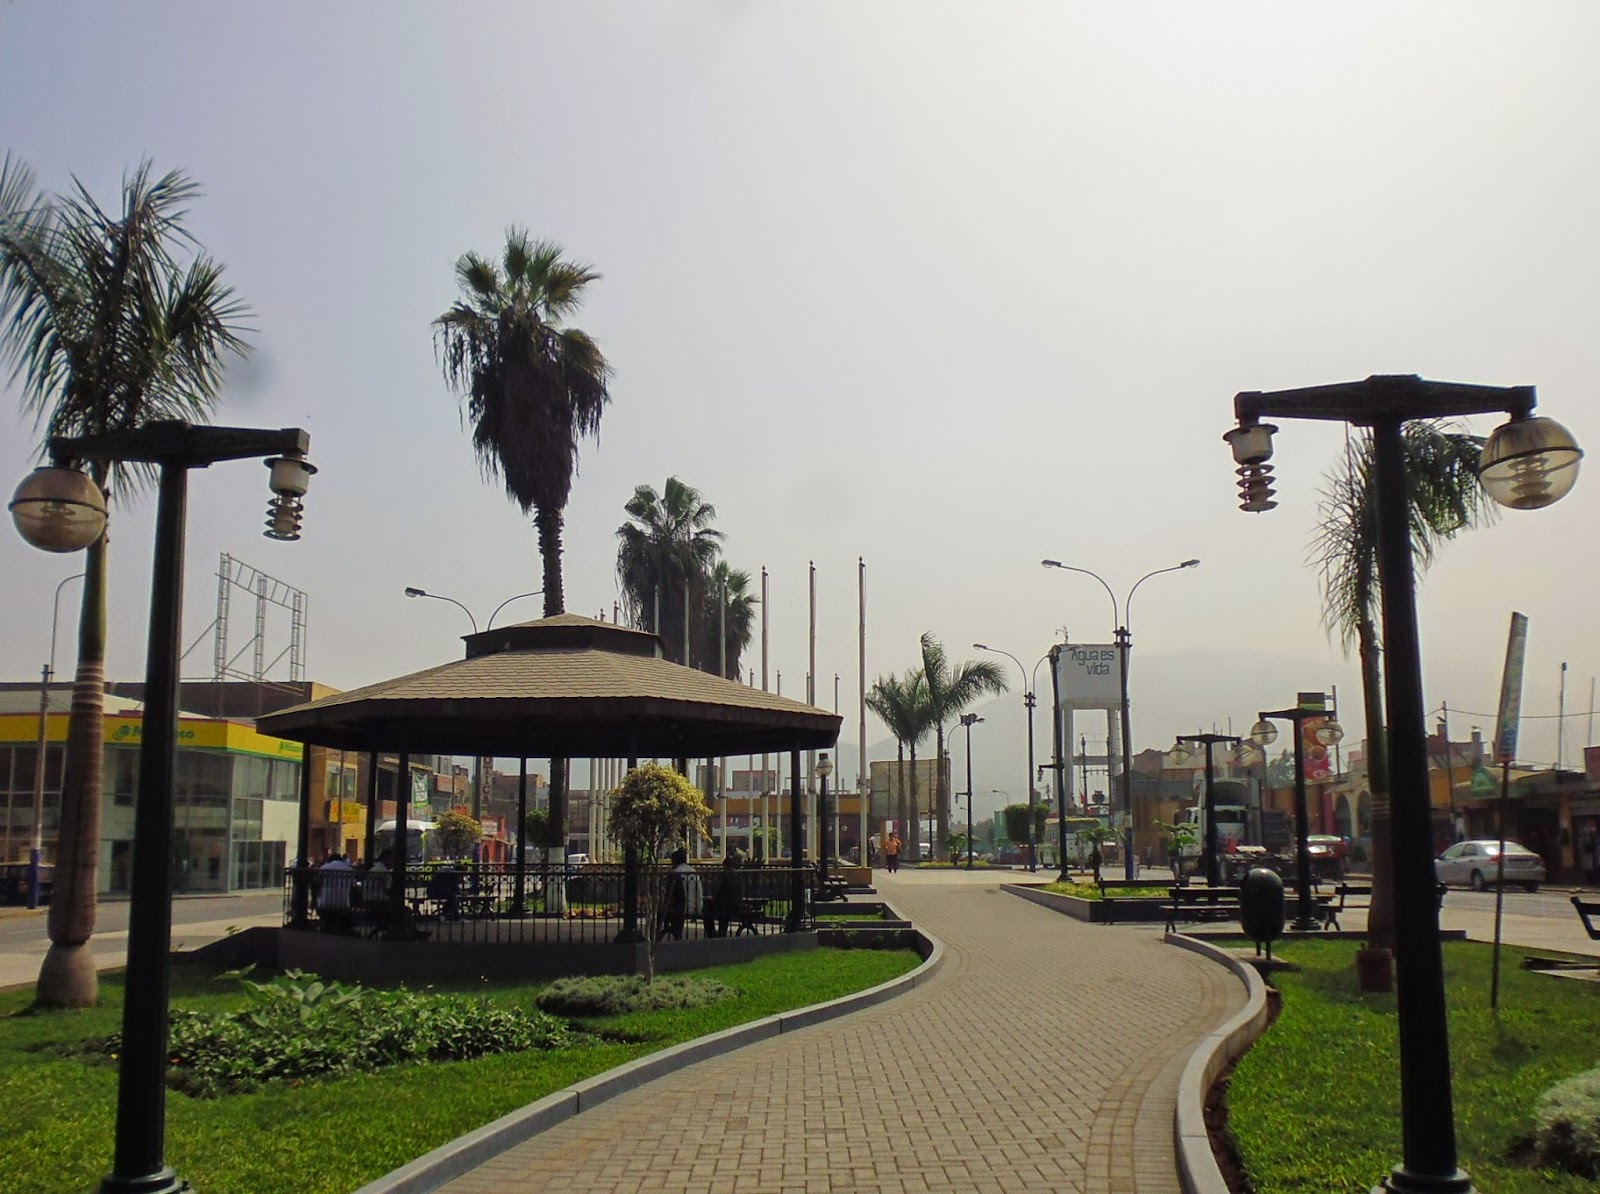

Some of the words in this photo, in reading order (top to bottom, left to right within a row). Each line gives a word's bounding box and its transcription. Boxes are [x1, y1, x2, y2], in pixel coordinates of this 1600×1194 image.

[1071, 649, 1098, 665] Agua
[1101, 650, 1115, 661] es
[1087, 662, 1110, 675] vida
[482, 756, 492, 804] OTICA
